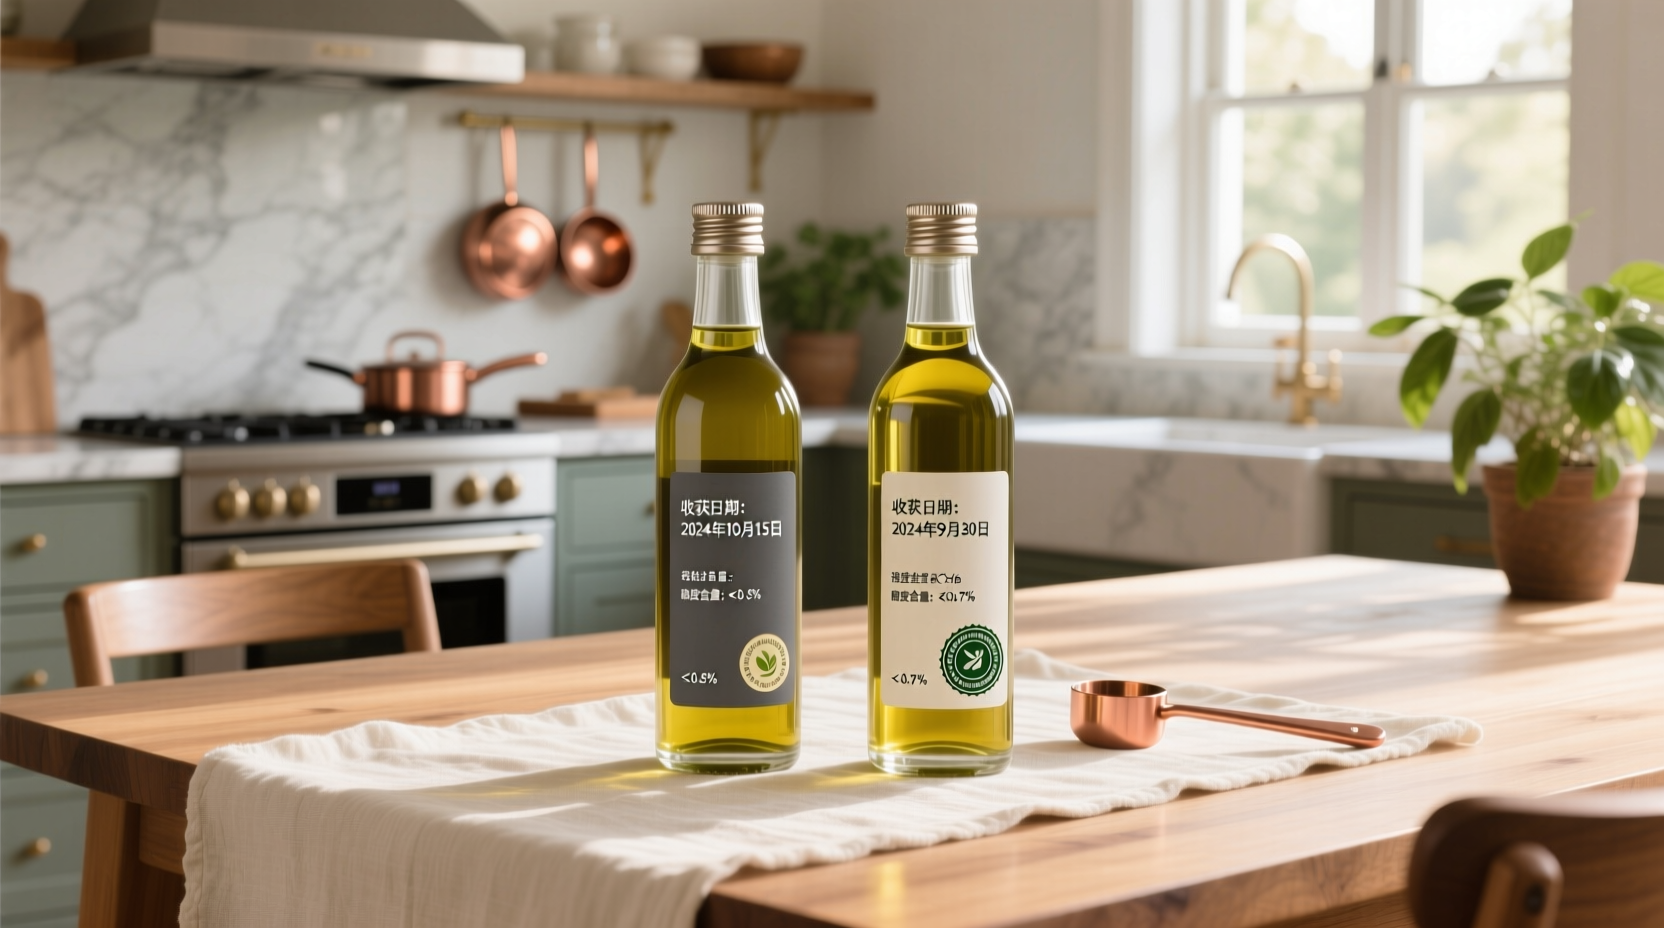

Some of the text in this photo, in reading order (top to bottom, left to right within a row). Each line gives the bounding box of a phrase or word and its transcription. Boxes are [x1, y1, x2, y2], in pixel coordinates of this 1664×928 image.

[680, 520, 782, 538] 2024年10月15日
[891, 520, 989, 538] 2024年9月30日
[891, 672, 928, 686] <0.7%
